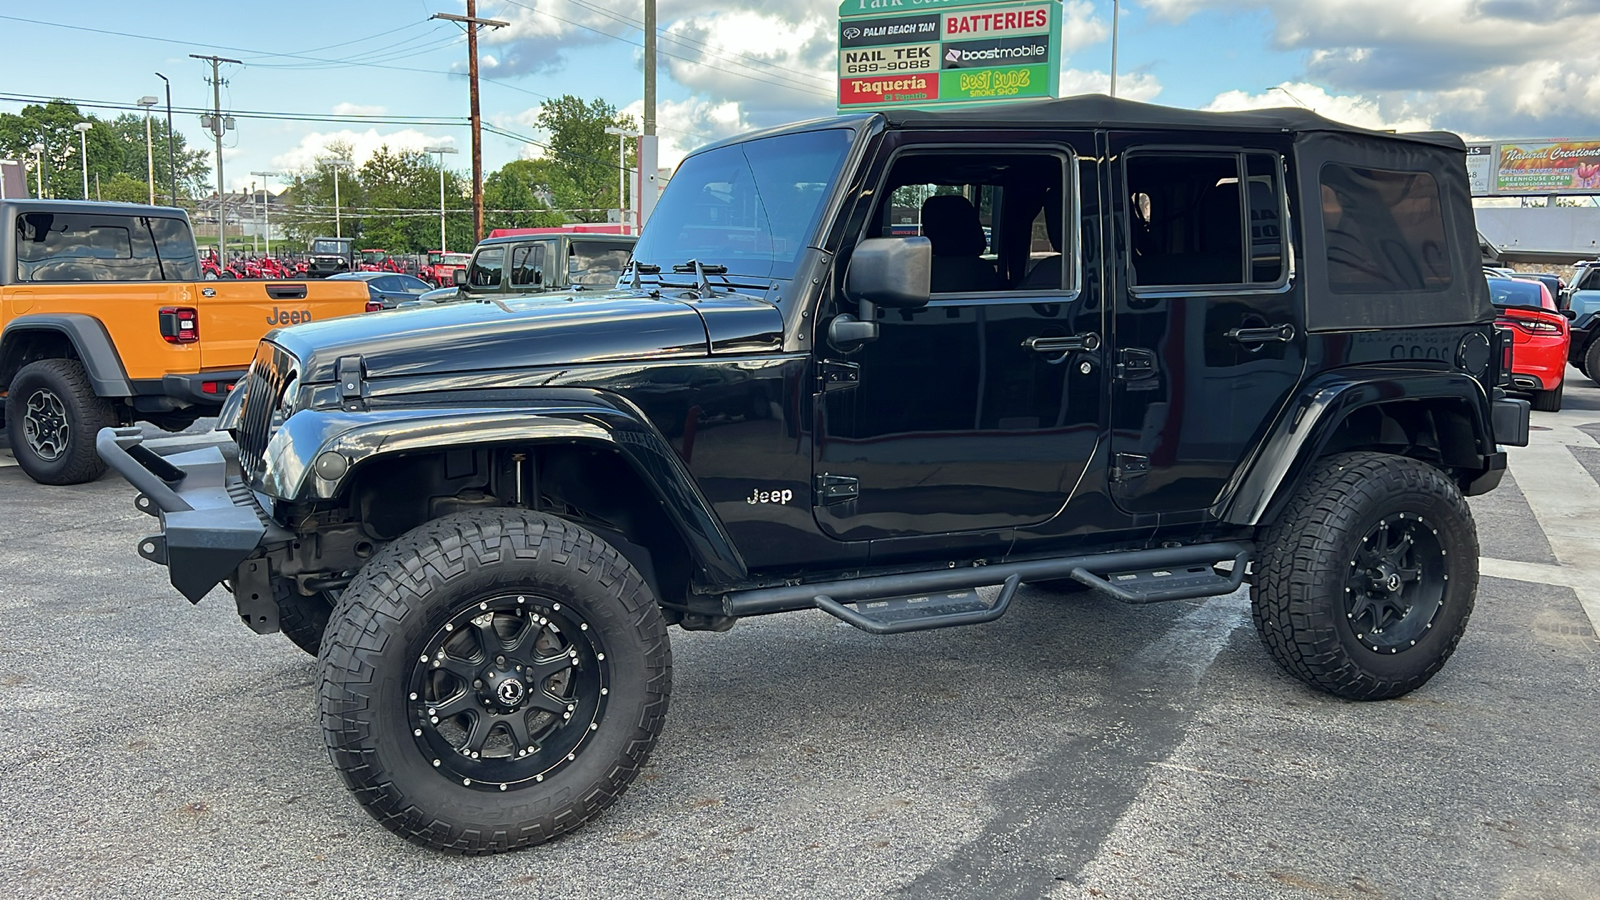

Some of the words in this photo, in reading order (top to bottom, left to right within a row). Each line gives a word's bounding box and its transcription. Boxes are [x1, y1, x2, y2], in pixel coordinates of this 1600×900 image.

[863, 26, 887, 37] PALM
[887, 23, 917, 35] BEACH
[918, 22, 936, 32] TAN
[947, 9, 1047, 34] BATTERIES
[846, 50, 886, 63] NAIL
[894, 46, 931, 59] TEK
[848, 59, 930, 73] 689-9088
[993, 69, 1031, 89] BUDZ
[970, 88, 996, 97] SMOKE
[997, 86, 1019, 96] SHOP
[1506, 148, 1549, 161] Natural
[1550, 146, 1600, 160] Creations
[266, 306, 312, 325] Jeep
[747, 488, 793, 505] Jeep
